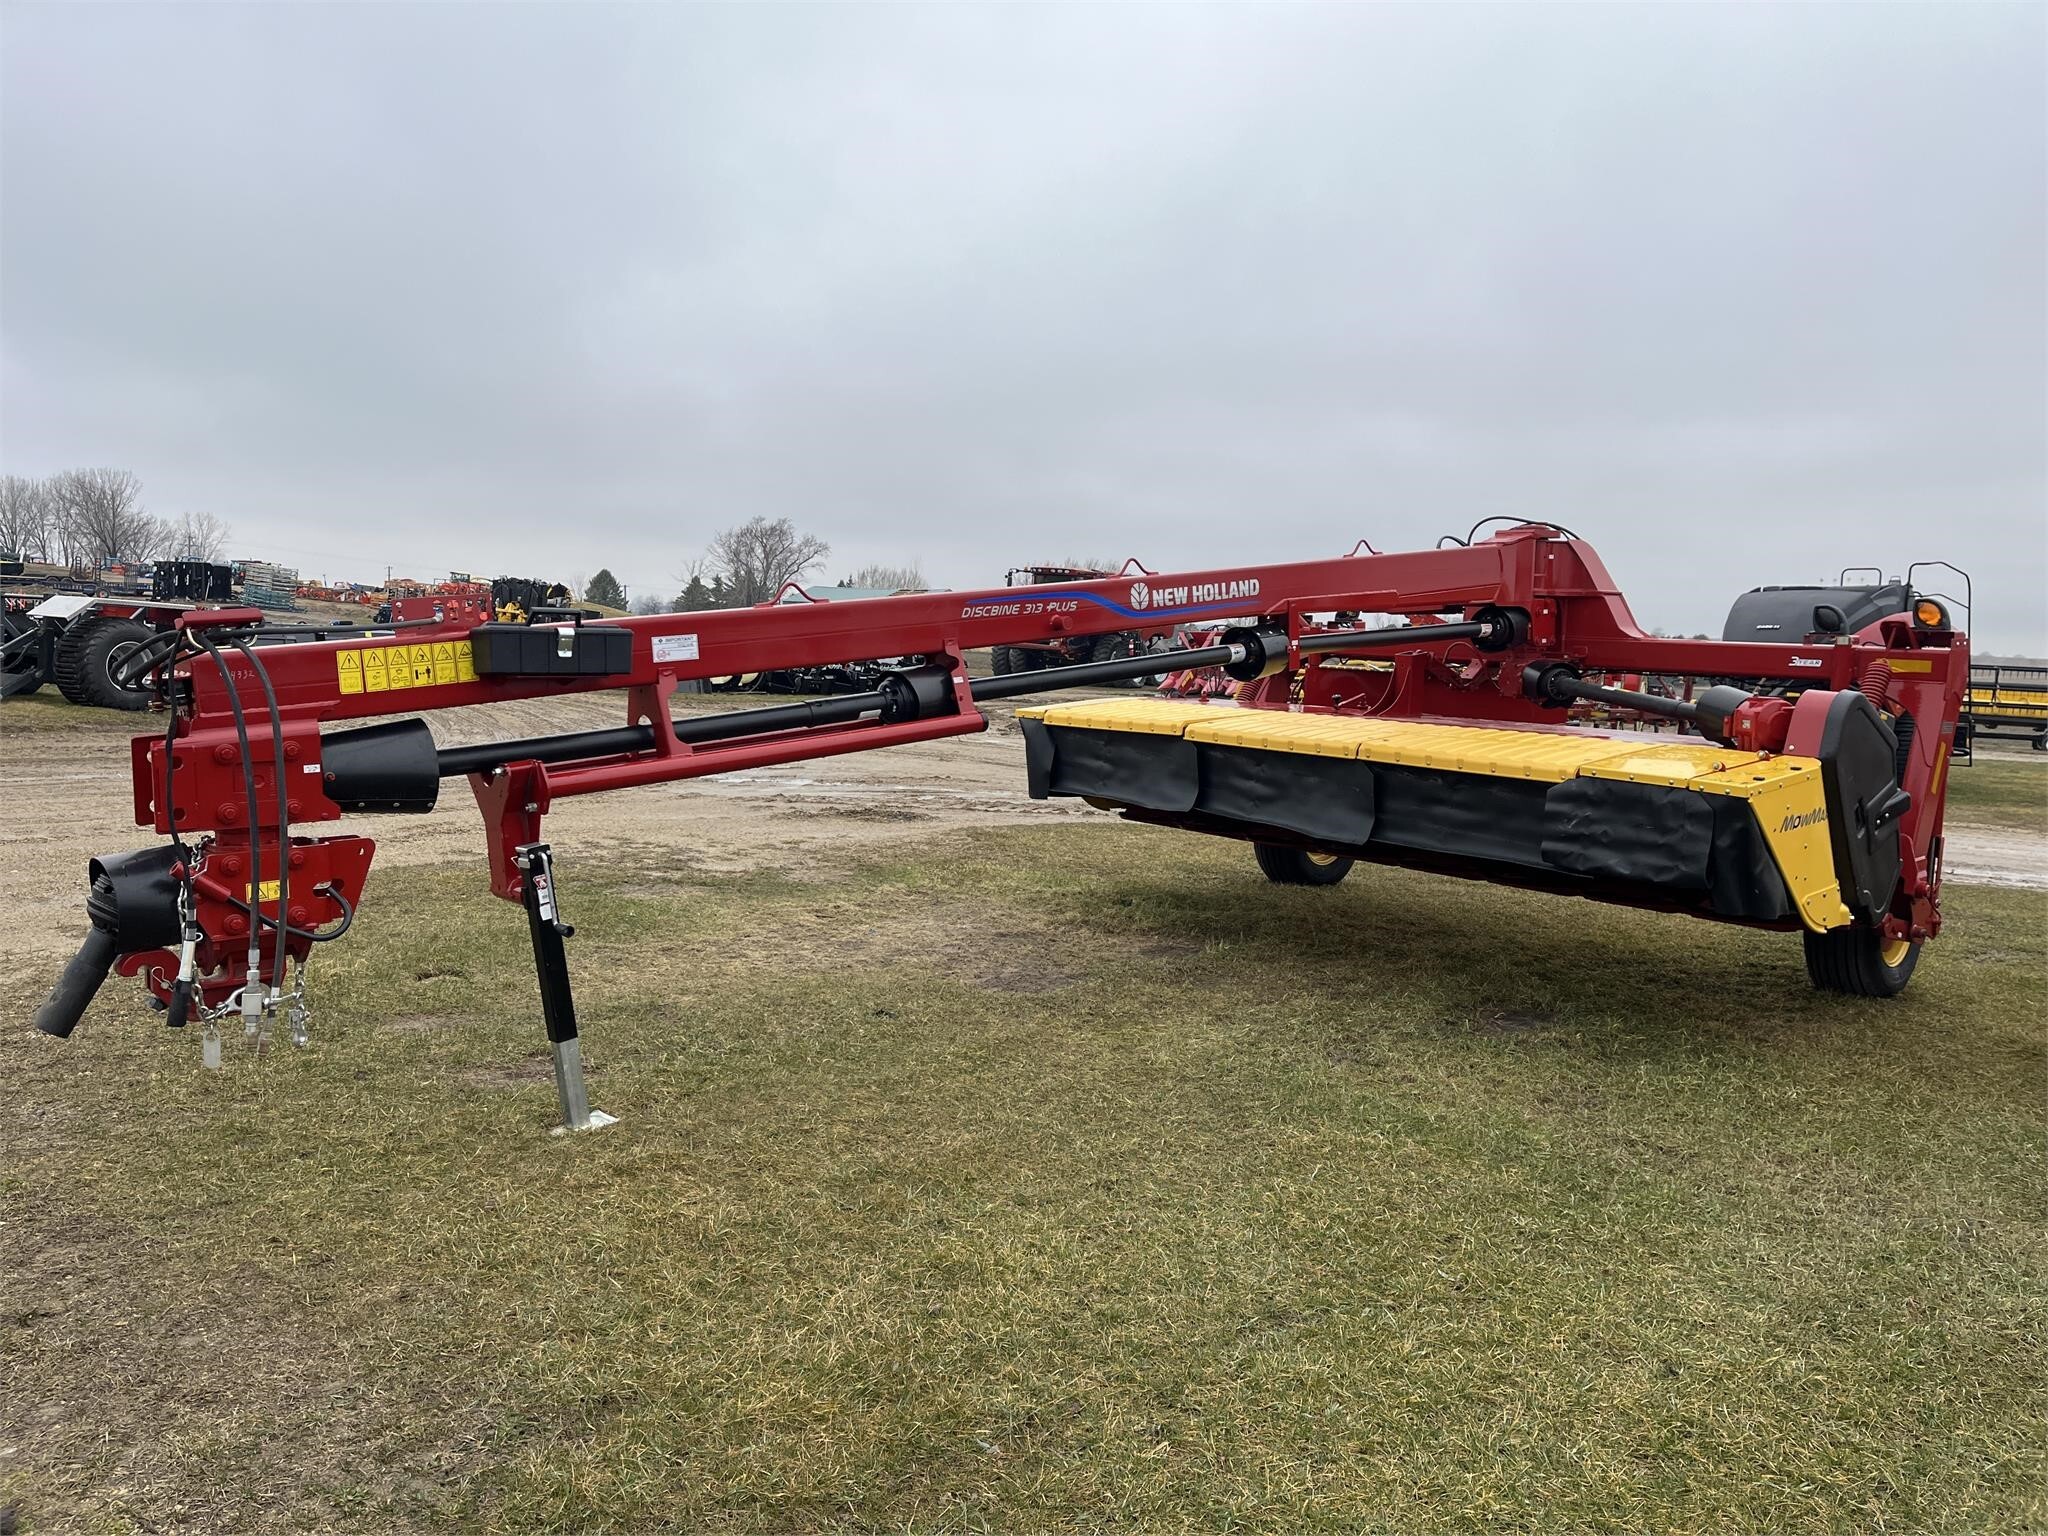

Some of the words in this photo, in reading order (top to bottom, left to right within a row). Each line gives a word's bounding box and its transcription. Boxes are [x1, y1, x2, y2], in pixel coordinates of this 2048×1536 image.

[1152, 587, 1188, 607] NEW
[1192, 579, 1260, 603] HOLLAND
[961, 604, 1020, 618] DISCBINE
[1023, 603, 1043, 614] 313
